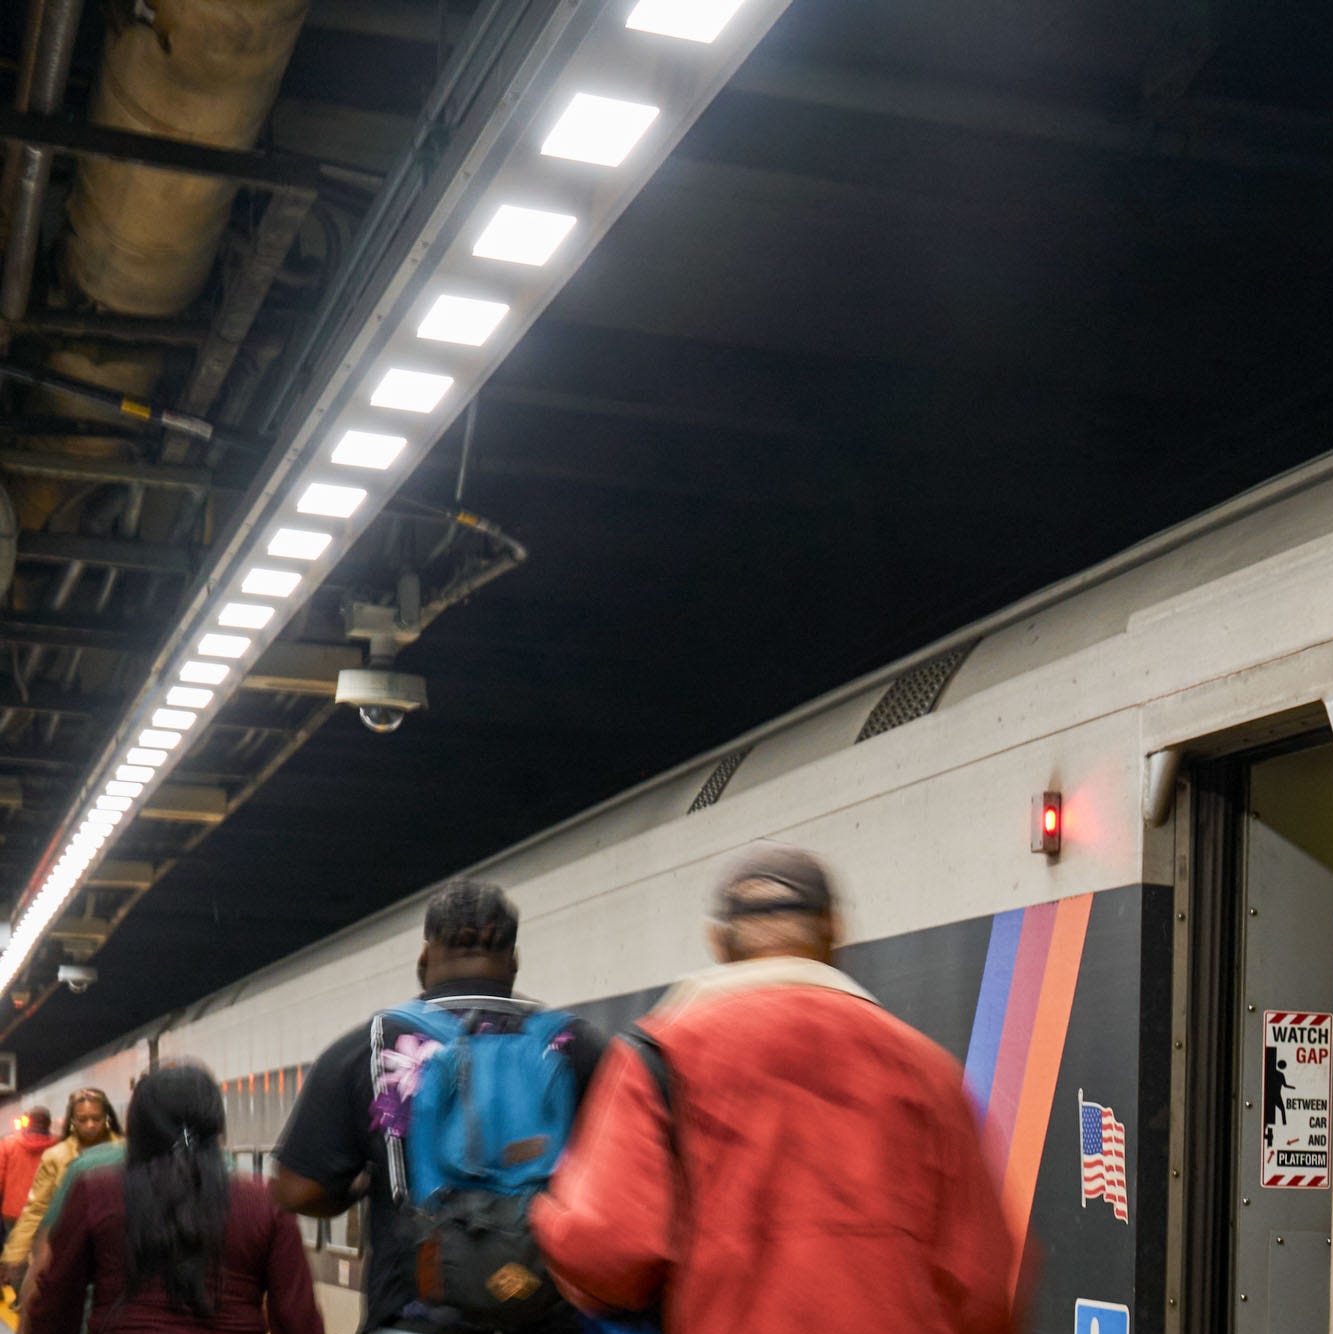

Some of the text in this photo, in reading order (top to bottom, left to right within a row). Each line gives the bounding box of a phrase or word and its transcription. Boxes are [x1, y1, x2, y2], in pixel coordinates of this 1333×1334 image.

[1272, 1026, 1329, 1044] WATCH
[1296, 1047, 1329, 1064] GAP
[1286, 1098, 1328, 1111] BETWEEN
[1309, 1116, 1327, 1129] CAR
[1308, 1134, 1327, 1147] AND
[1278, 1152, 1327, 1167] PLATFORM
